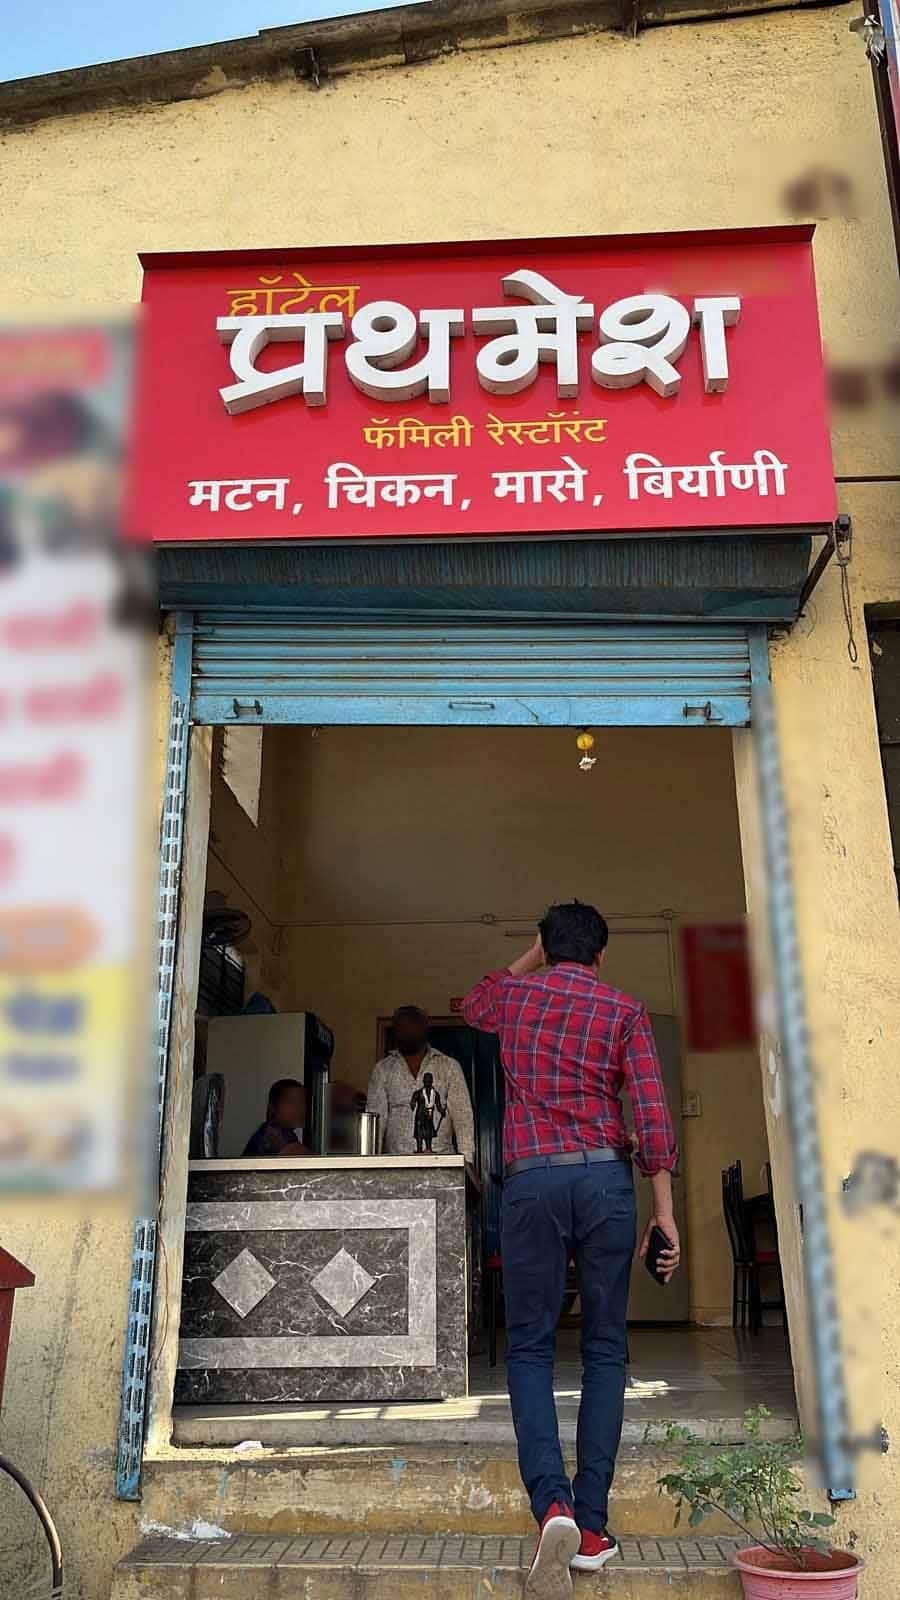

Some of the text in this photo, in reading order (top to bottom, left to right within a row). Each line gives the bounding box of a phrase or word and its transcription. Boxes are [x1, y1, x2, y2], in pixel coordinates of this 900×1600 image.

[226, 272, 361, 317] हॉटेल
[216, 268, 741, 415] प्रथमेश
[363, 411, 608, 449] फॅमिली रेस्टॉरंट
[188, 449, 788, 515] मटन, चिकन, मासे, बिर्याणी
